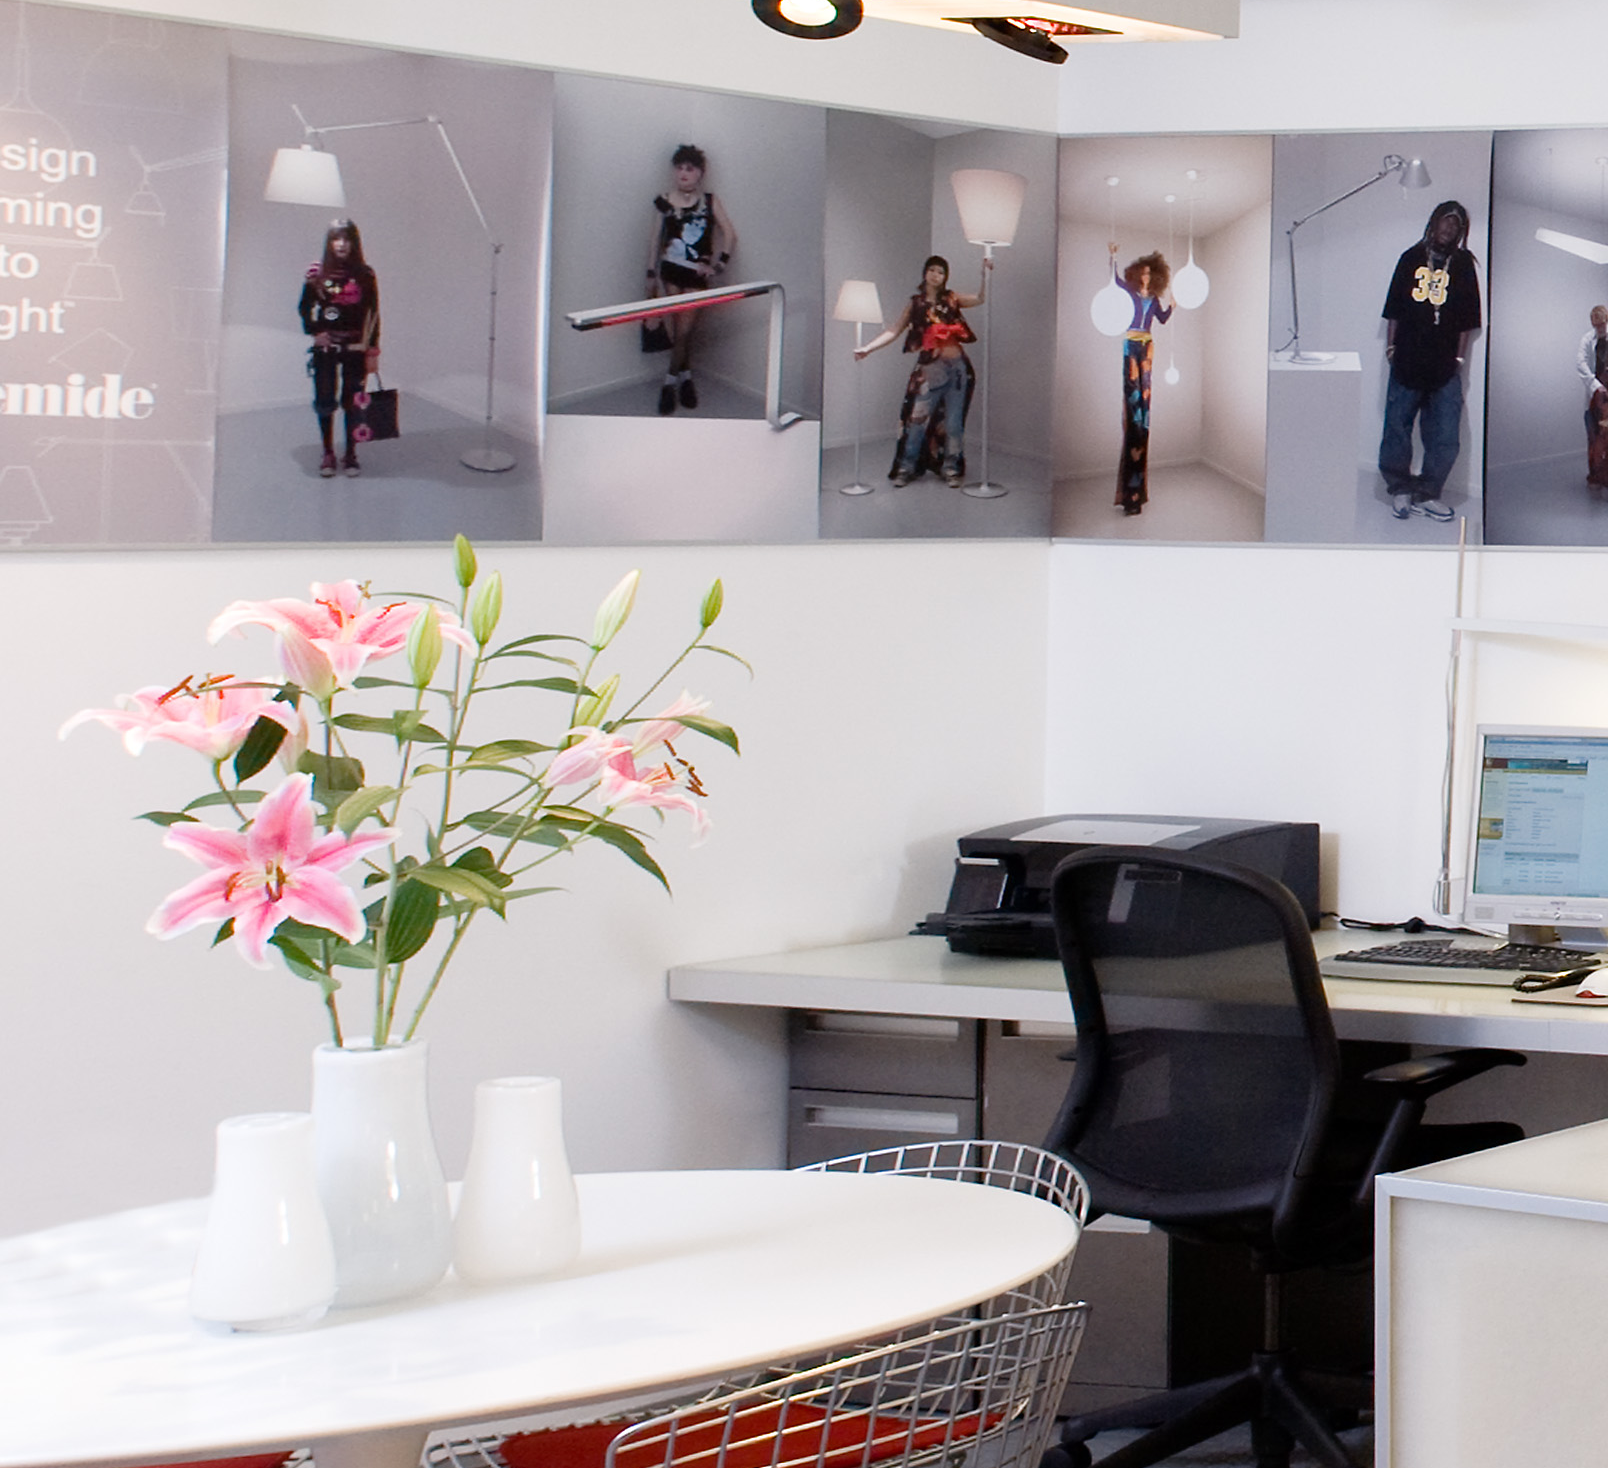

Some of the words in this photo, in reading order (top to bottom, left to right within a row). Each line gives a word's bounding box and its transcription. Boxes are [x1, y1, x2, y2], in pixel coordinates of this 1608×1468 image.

[0, 137, 97, 183] sign
[1411, 266, 1450, 306] 33
[0, 373, 155, 419] mide
